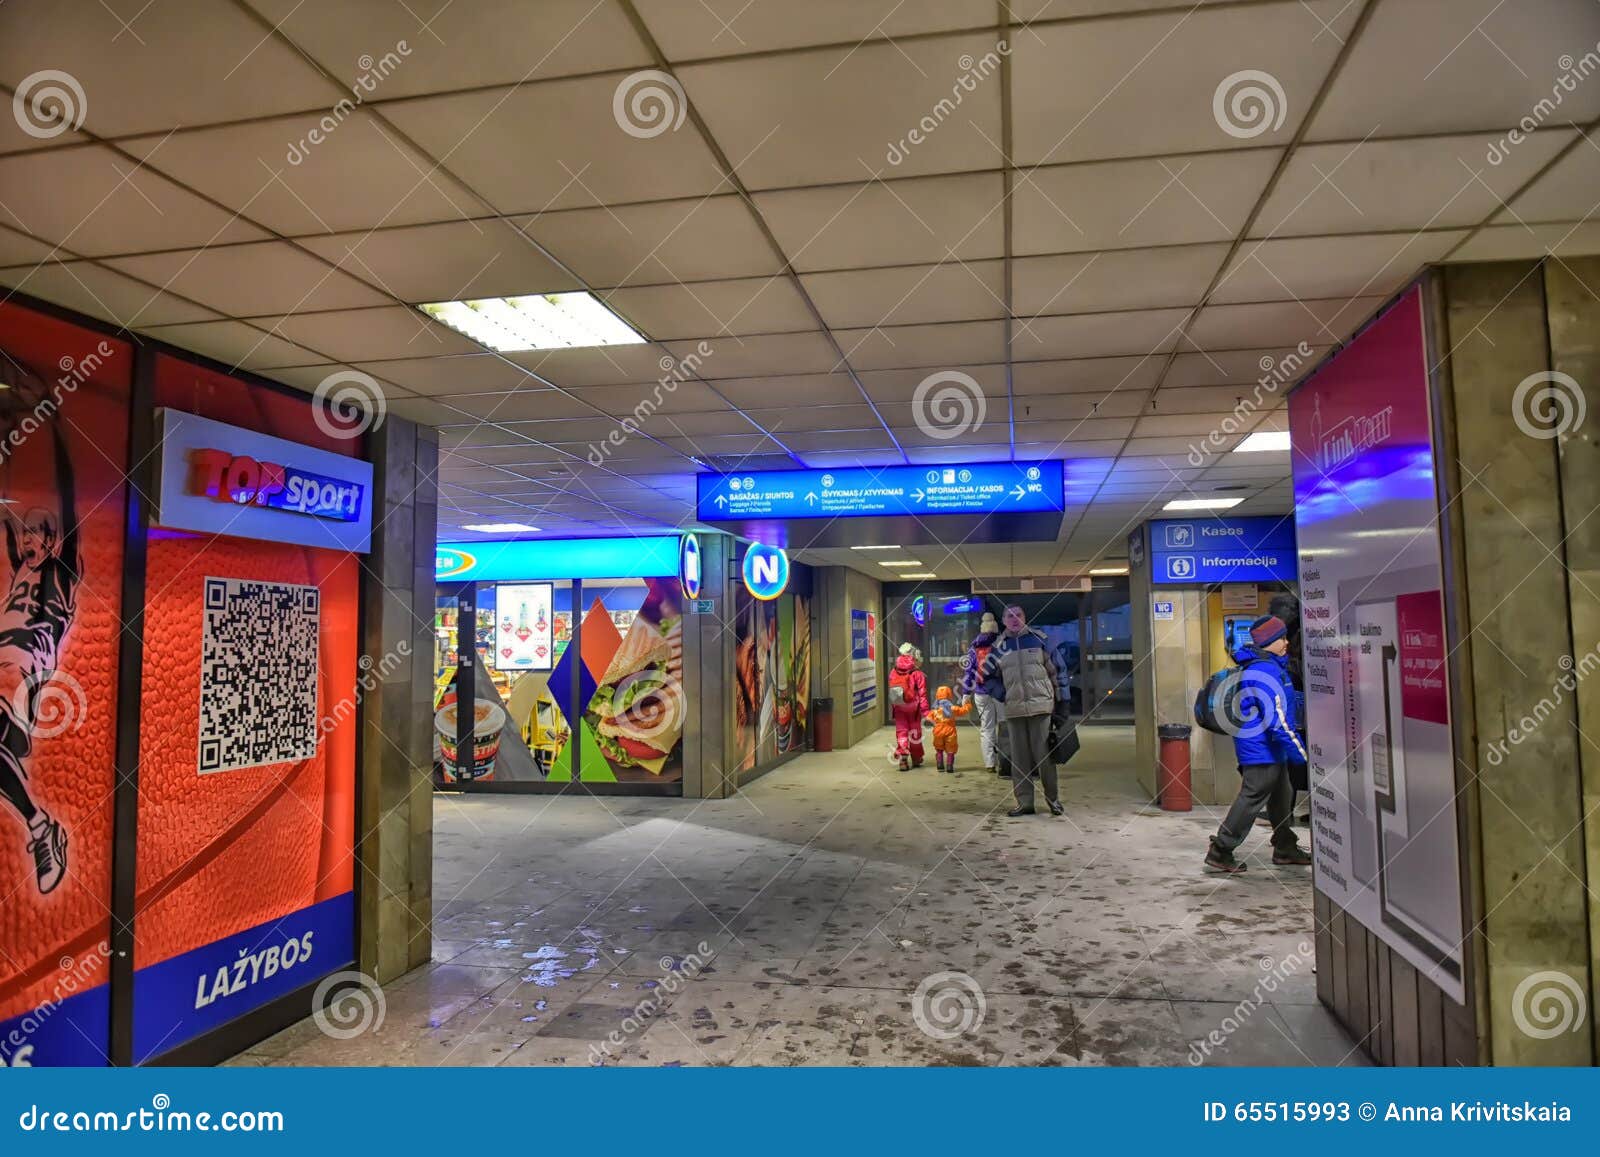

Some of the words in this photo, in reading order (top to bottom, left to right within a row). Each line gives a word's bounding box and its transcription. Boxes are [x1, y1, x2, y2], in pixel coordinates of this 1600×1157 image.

[864, 488, 904, 497] ATVYKIMAS
[926, 486, 974, 495] INFORMACIJA
[979, 485, 1004, 493] KASOS
[1027, 483, 1042, 493] WC
[765, 491, 794, 500] SIUNTOS
[1202, 526, 1244, 537] Kasos
[1202, 556, 1277, 568] Informacija
[752, 554, 779, 583] N
[195, 930, 314, 1010] LAŽYBOS
